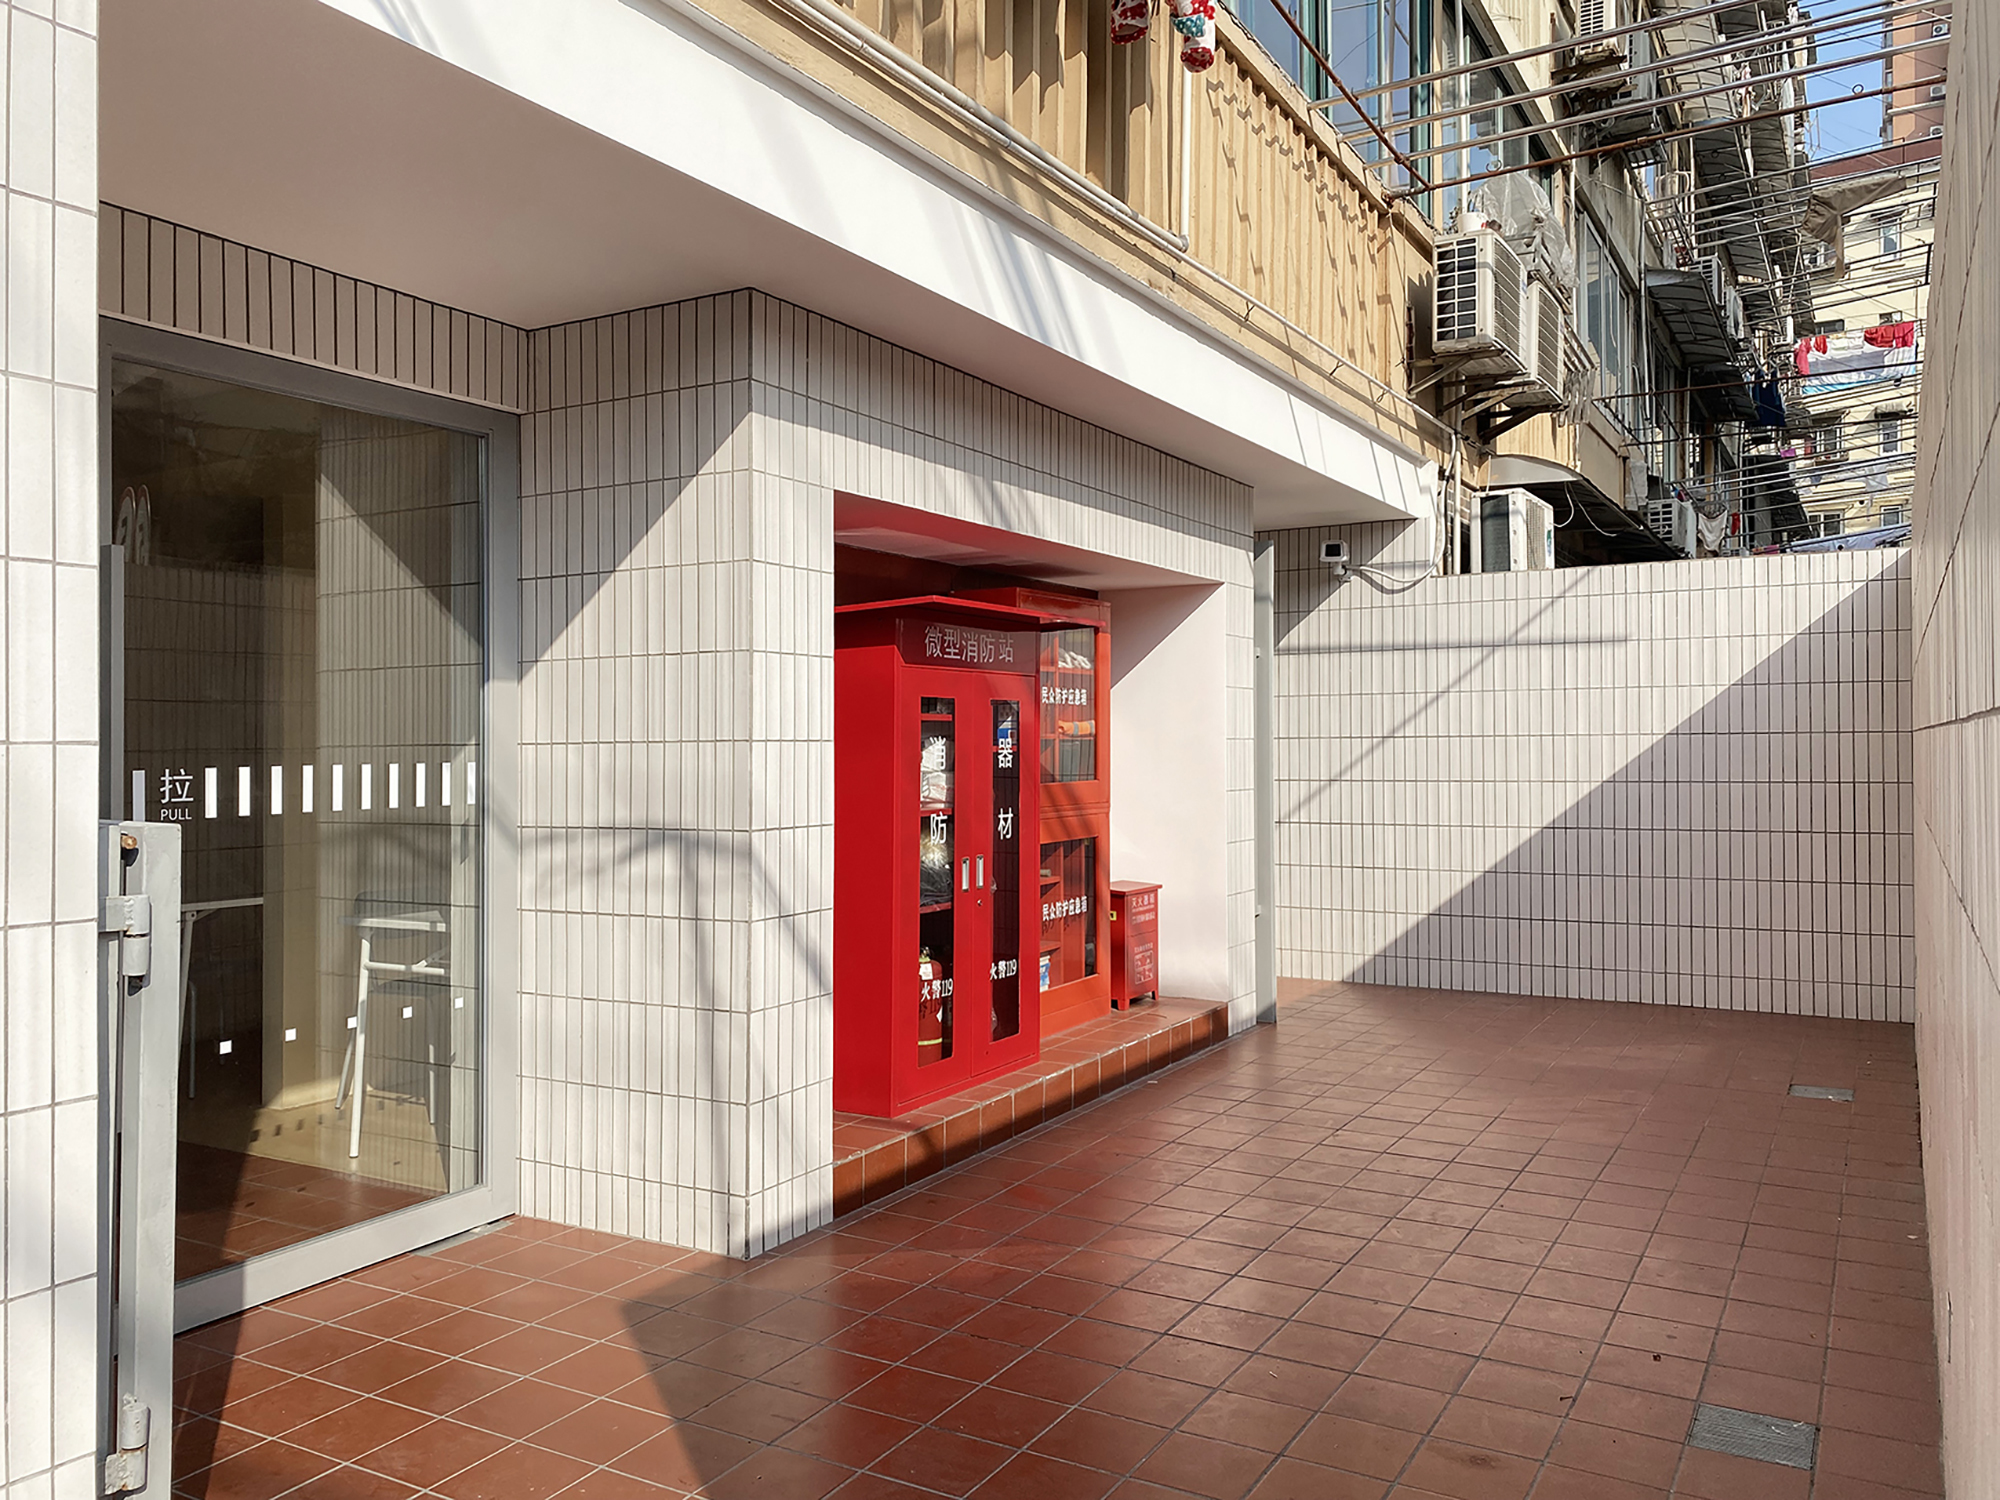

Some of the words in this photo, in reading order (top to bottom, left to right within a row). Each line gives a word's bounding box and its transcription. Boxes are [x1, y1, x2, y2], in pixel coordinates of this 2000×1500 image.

[924, 625, 1014, 663] 微型消防站
[1041, 686, 1087, 706] 民众防护应急箱
[160, 769, 194, 803] 拉
[160, 808, 192, 821] PULL
[1042, 895, 1088, 921] 民众防护应急箱
